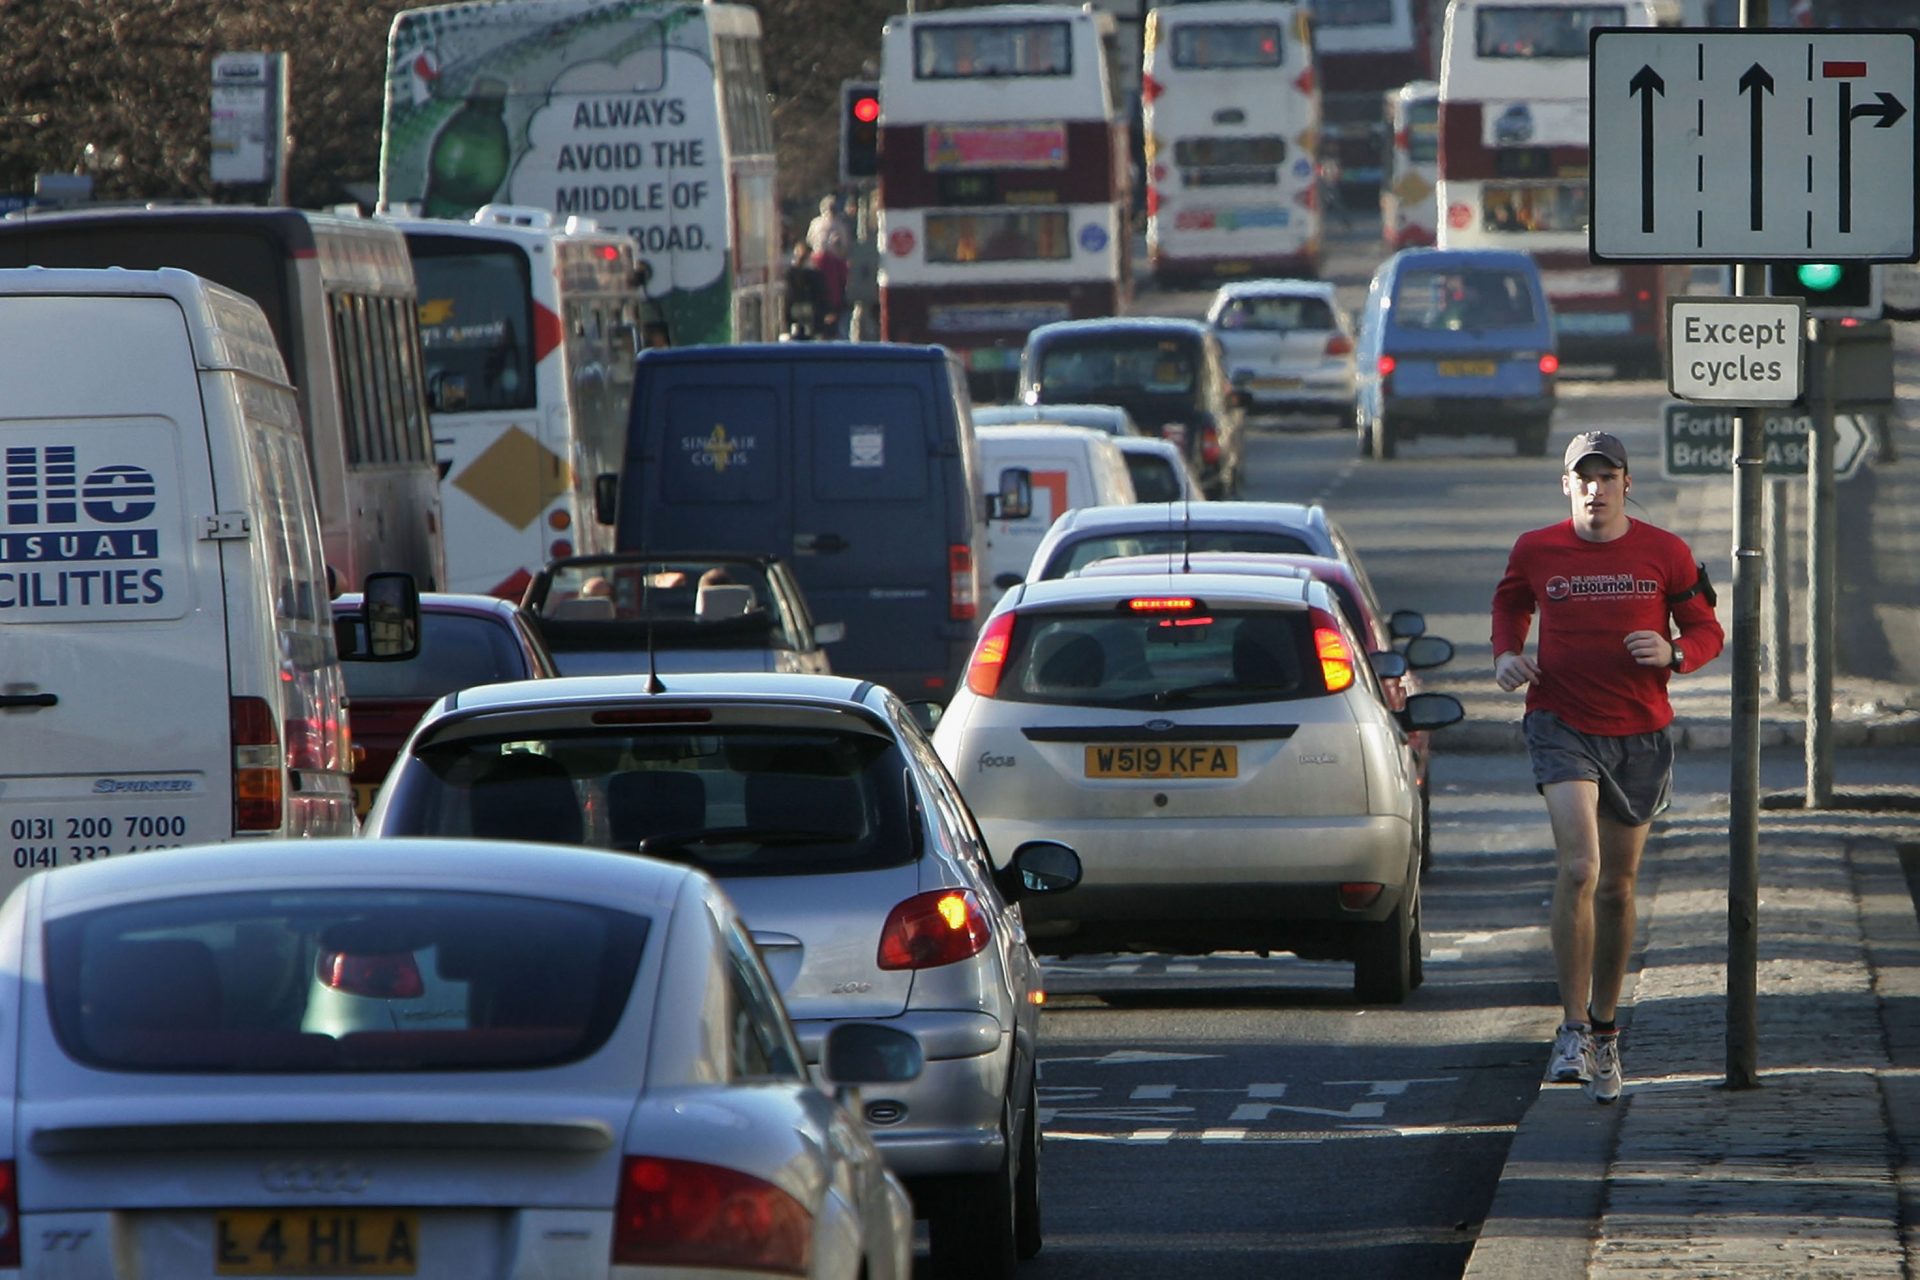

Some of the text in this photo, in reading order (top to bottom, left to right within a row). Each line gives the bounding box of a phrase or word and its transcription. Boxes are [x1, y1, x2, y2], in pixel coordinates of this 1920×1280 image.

[573, 98, 685, 130] ALWAYS
[556, 138, 704, 172] AVOID THE
[555, 180, 709, 214] MIDDLE OF
[628, 222, 712, 254] ROAD.
[1684, 316, 1787, 350] Except
[1690, 354, 1782, 387] cycles
[1764, 414, 1813, 435] oad
[1673, 441, 1734, 472] Bridg
[1571, 580, 1635, 595] RESOLUTION
[1097, 747, 1228, 773] W519 KFA
[11, 815, 186, 840] 0131 200 7000
[13, 846, 57, 868] 0141
[307, 1217, 416, 1265] HLA
